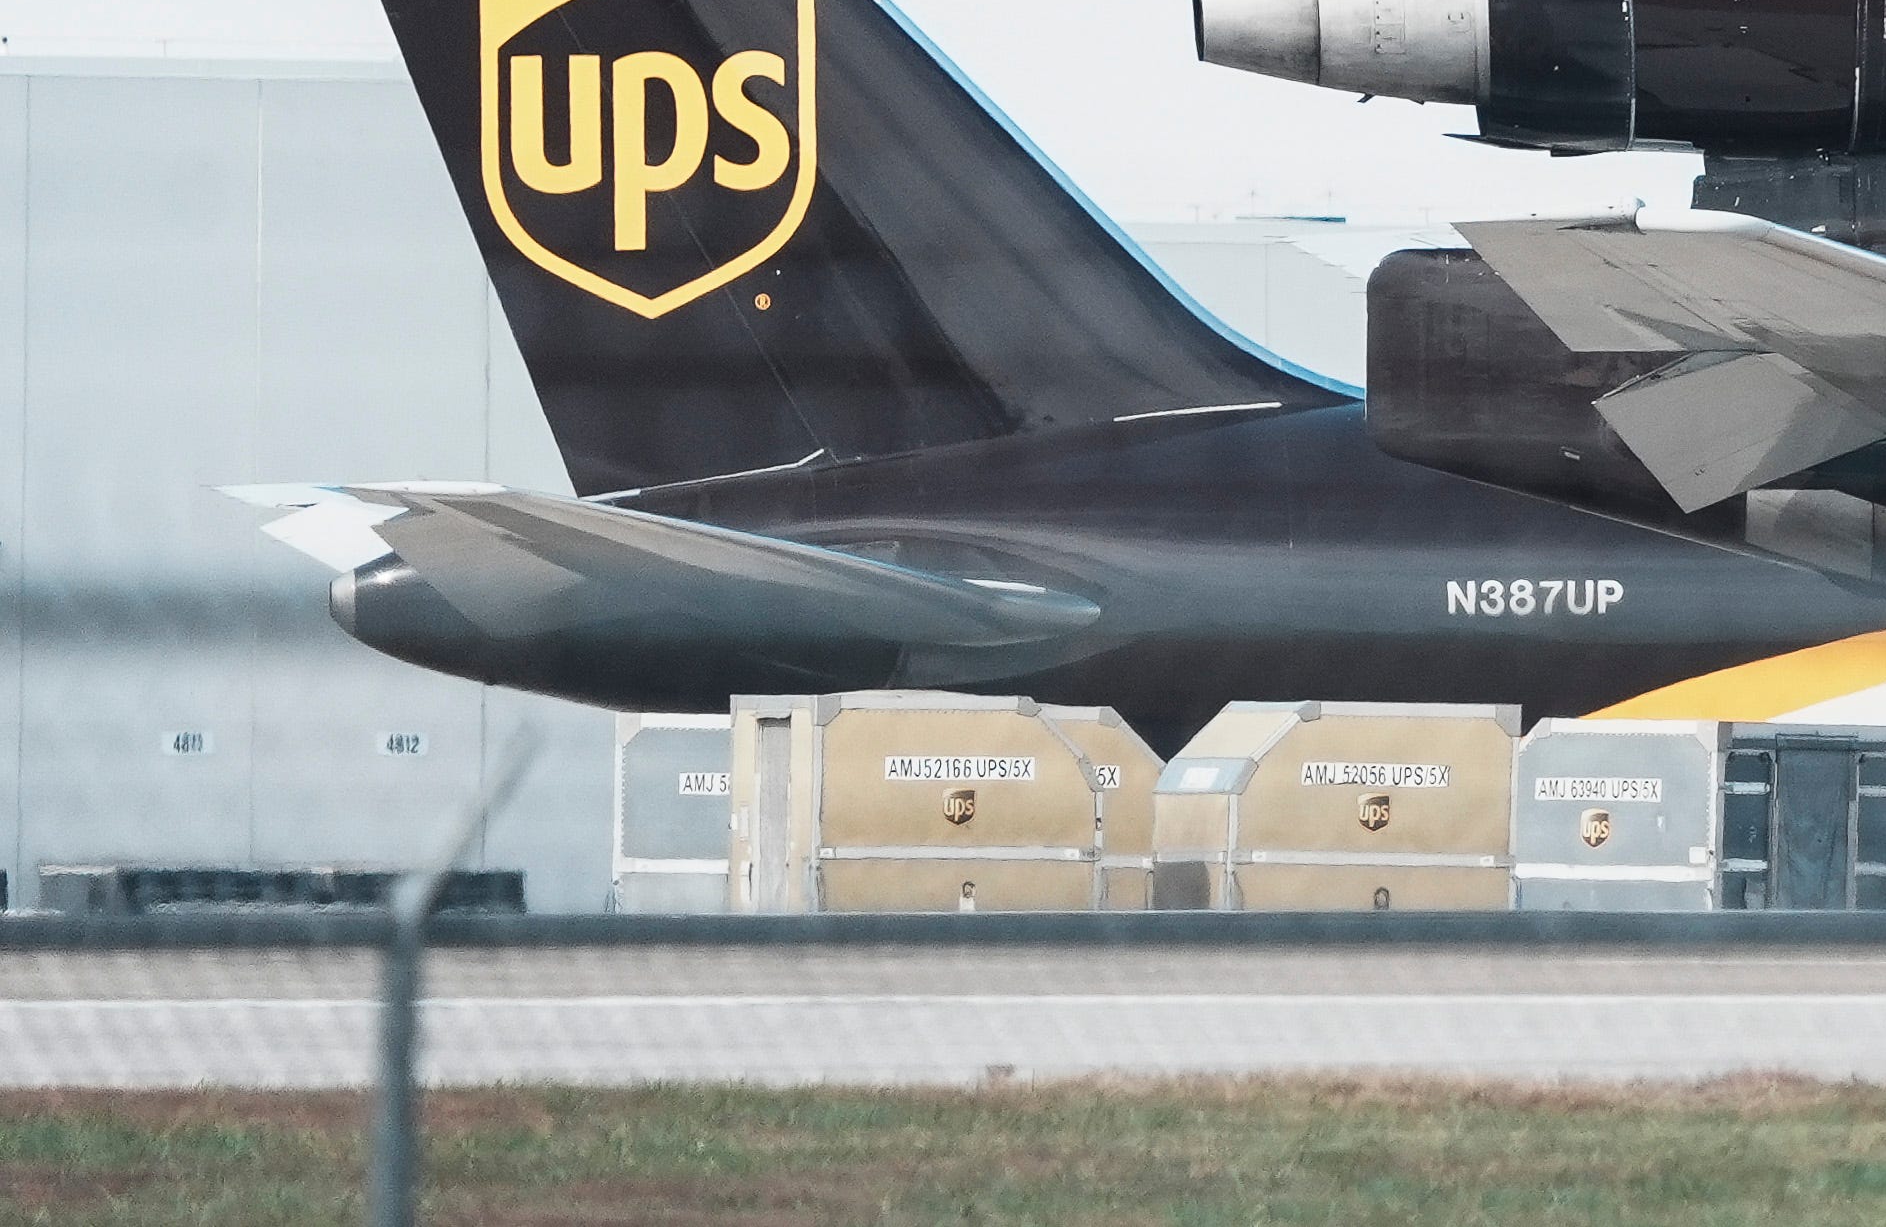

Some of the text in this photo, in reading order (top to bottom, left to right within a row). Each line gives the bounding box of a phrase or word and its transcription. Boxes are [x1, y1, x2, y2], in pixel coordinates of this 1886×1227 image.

[510, 50, 791, 251] ups
[1446, 579, 1624, 616] N387UP
[976, 758, 1032, 778] UPS/5X
[1303, 764, 1336, 784] AMJ
[1343, 765, 1386, 785] 52056
[682, 774, 730, 793] AMJ 5
[1538, 780, 1566, 798] AMJ
[1570, 780, 1607, 798] 63940
[943, 795, 975, 822] ups
[1358, 804, 1389, 827] ups
[1582, 820, 1610, 844] ups
